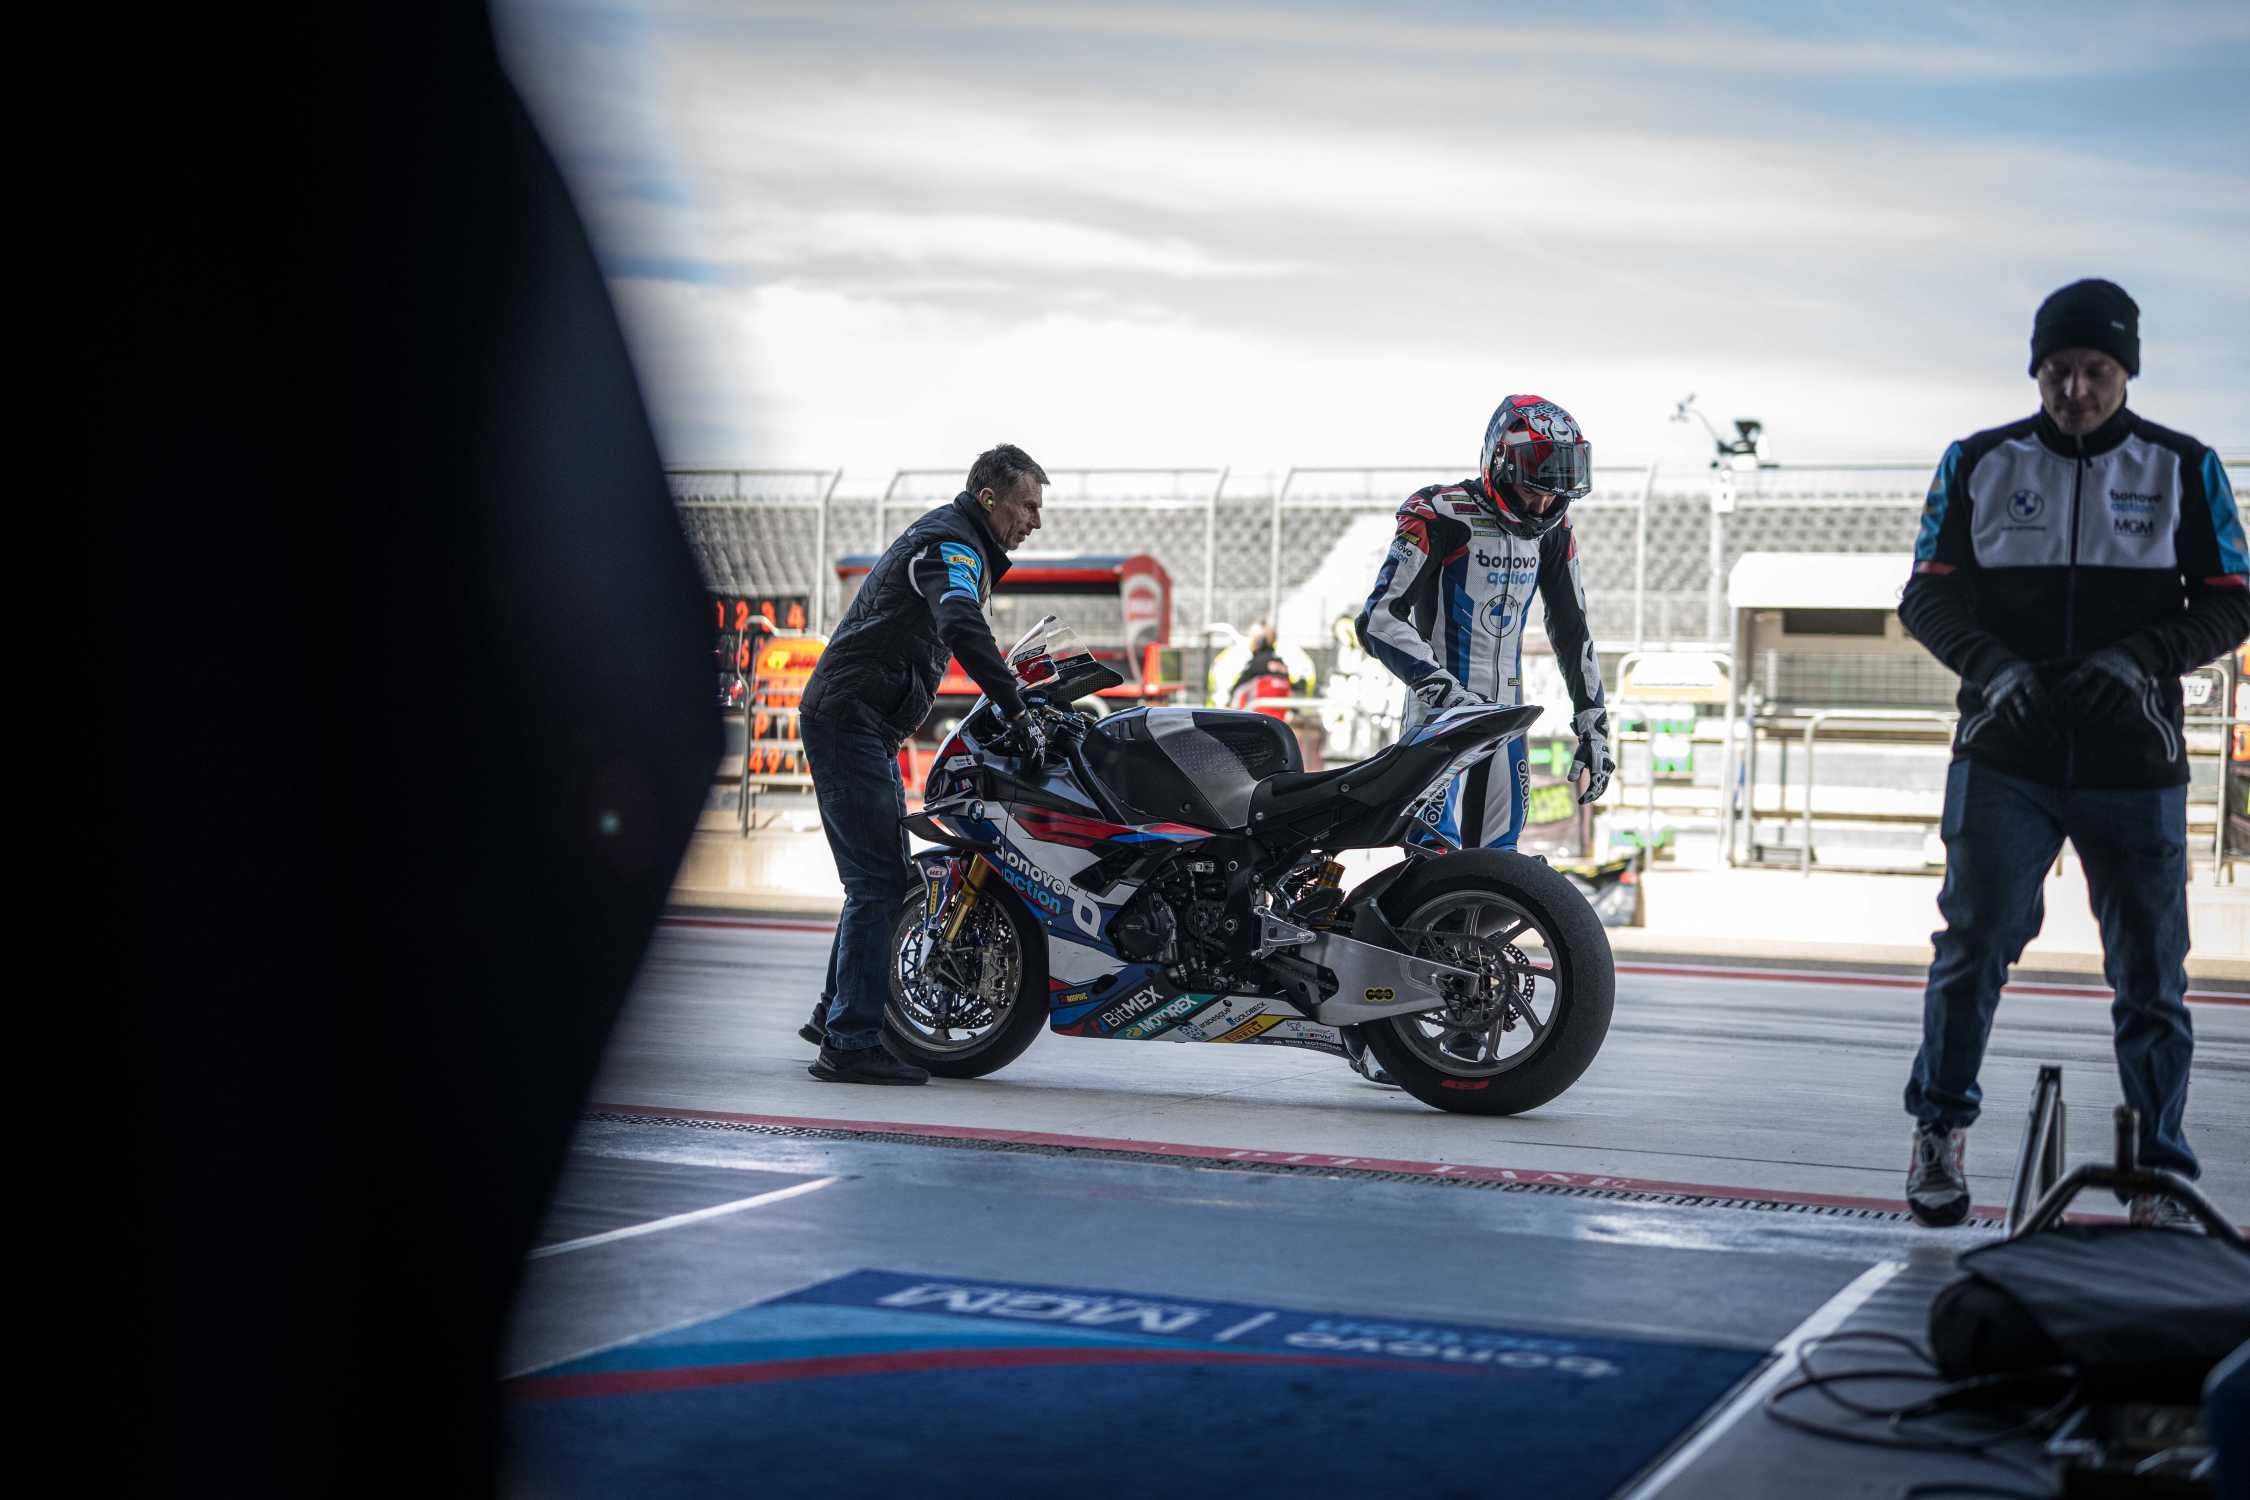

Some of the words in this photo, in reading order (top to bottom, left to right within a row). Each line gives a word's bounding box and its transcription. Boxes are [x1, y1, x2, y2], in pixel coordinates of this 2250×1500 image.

[2114, 518, 2155, 535] MGM
[1475, 549, 1537, 569] bonovo
[1487, 571, 1535, 586] action
[736, 601, 750, 631] 2
[993, 836, 1065, 896] bonovo
[1004, 867, 1060, 915] action
[1102, 985, 1165, 1027] BitMEX
[1138, 994, 1198, 1033] MOTOREX
[1224, 1020, 1263, 1041] PIRELLI
[1432, 1165, 1631, 1188] LANE
[876, 1283, 1212, 1333] MGM
